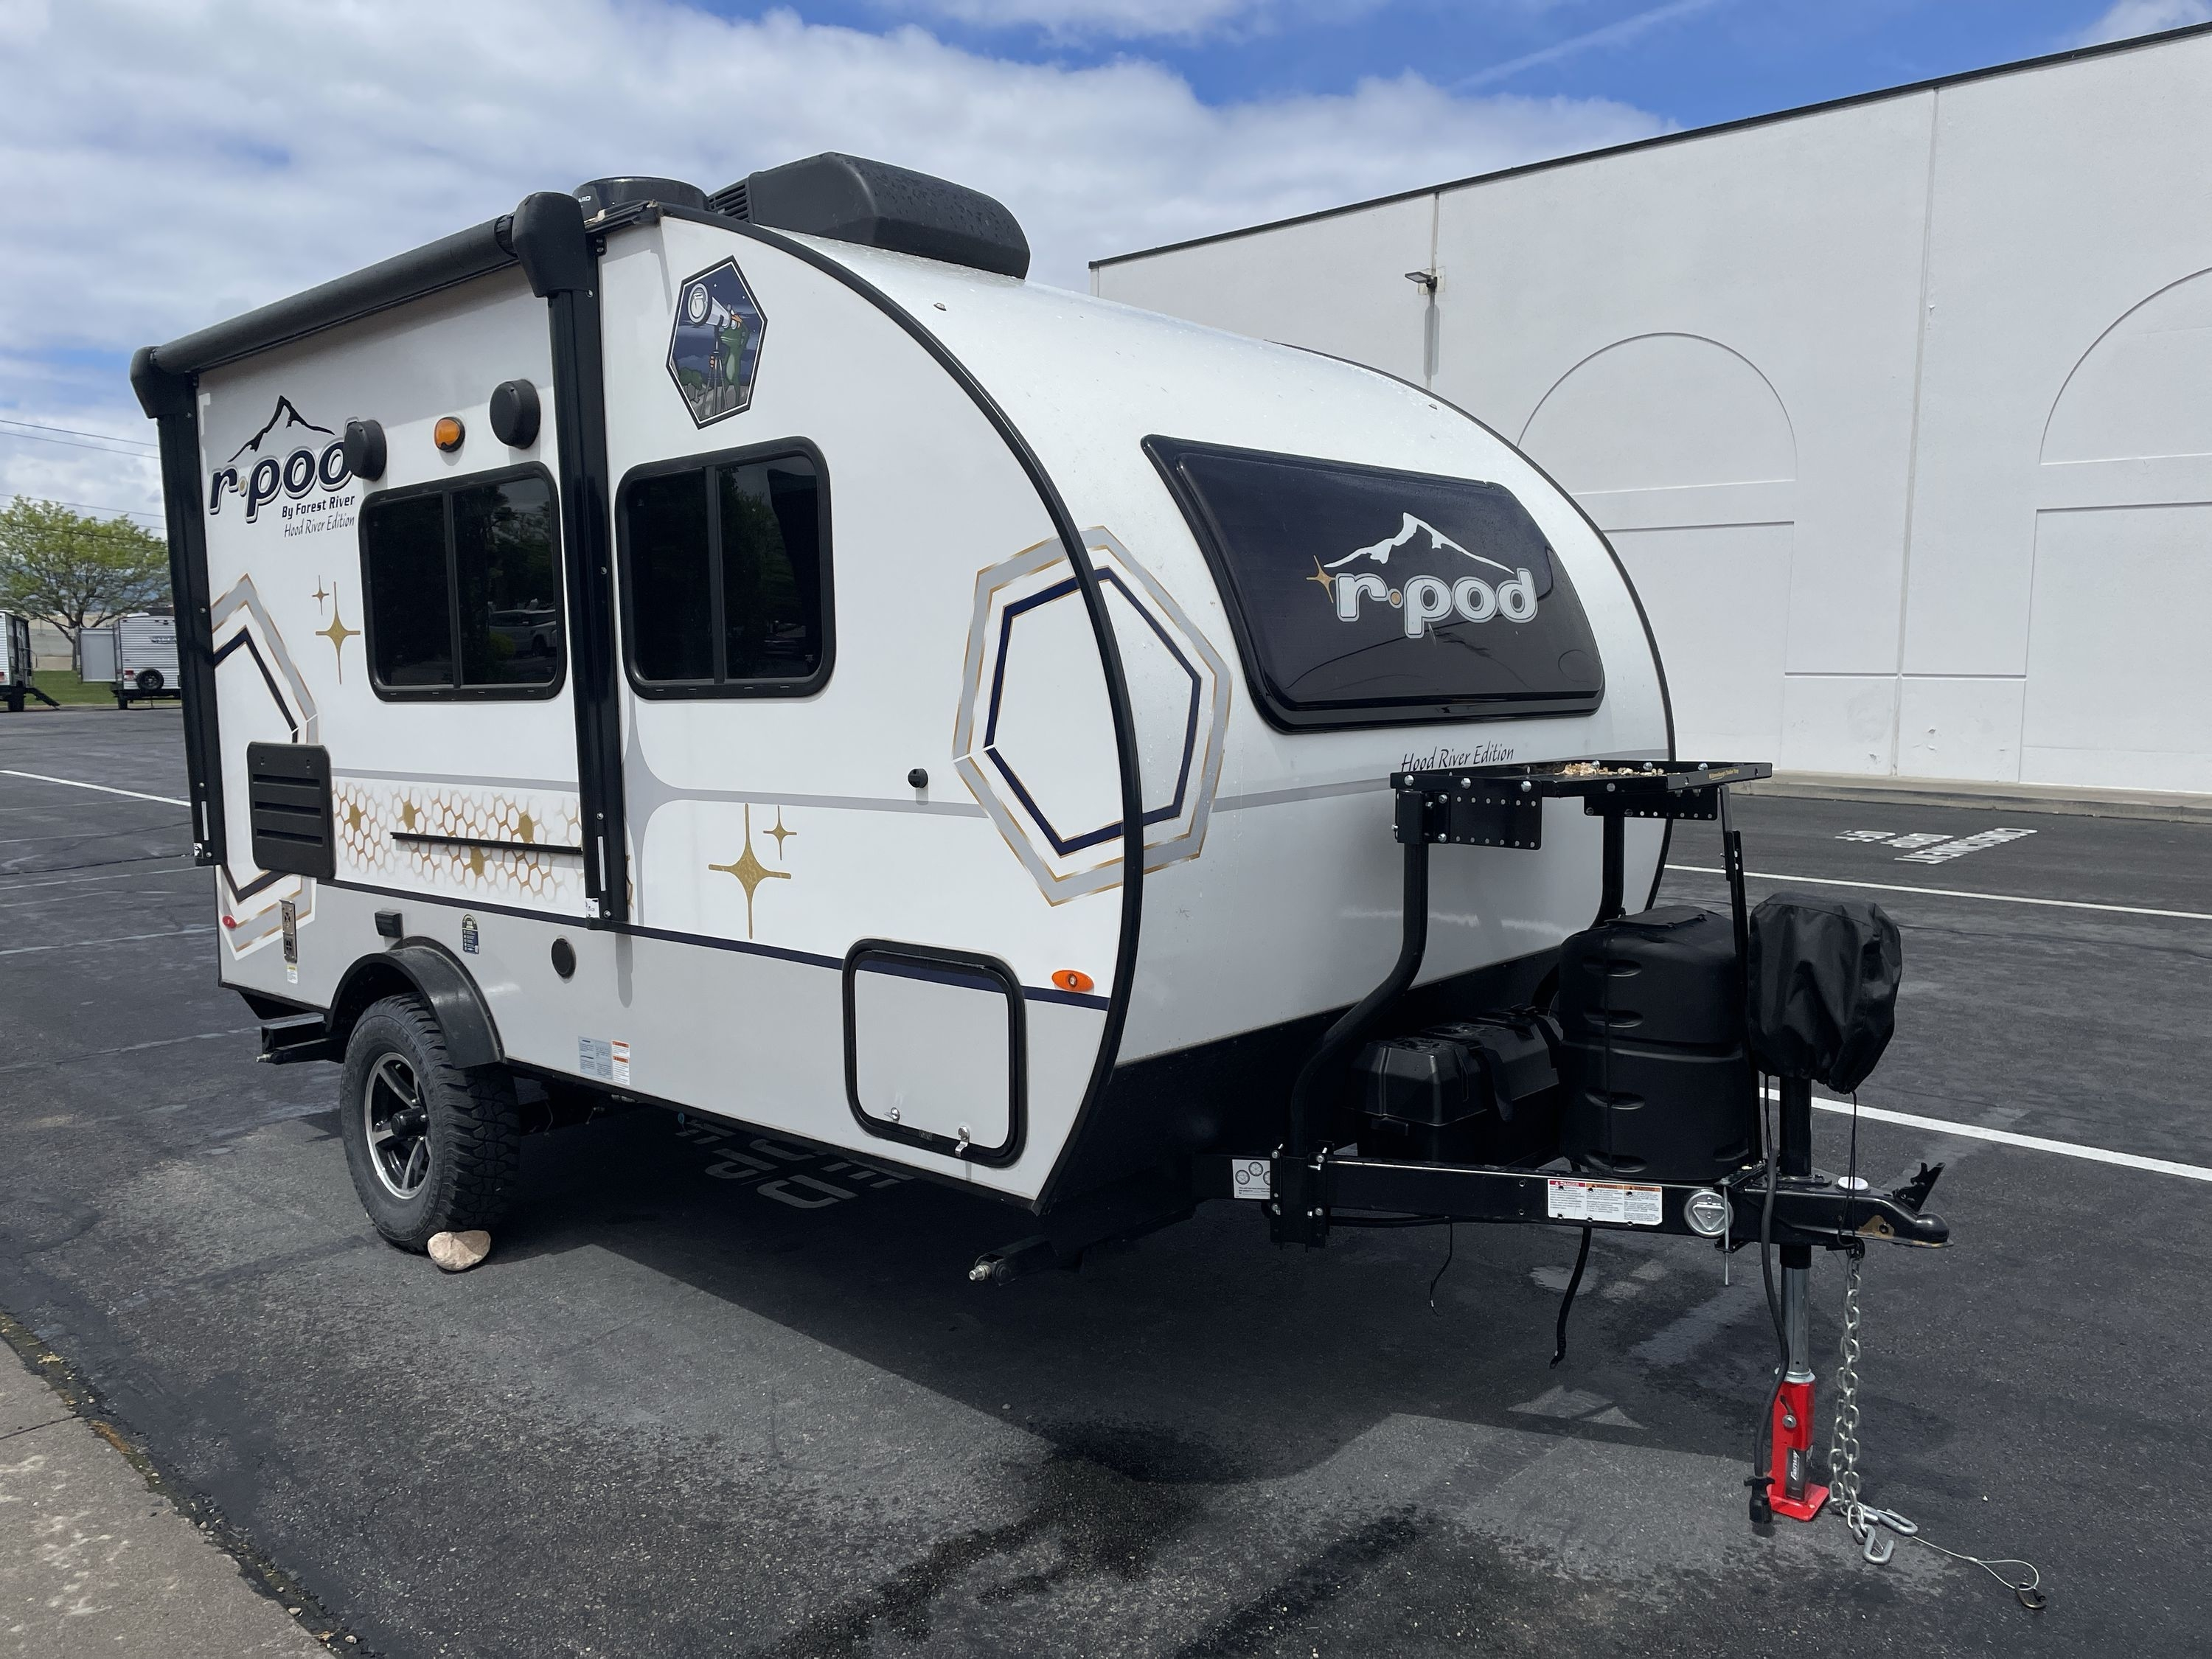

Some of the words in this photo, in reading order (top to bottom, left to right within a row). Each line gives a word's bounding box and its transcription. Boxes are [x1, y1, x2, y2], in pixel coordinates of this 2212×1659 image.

[282, 506, 294, 520] By
[296, 500, 327, 515] Forest
[329, 495, 355, 509] River
[285, 518, 305, 538] Hood
[305, 519, 325, 533] River
[327, 511, 354, 531] Edition
[1402, 745, 1437, 772] Hood
[1439, 748, 1471, 768] River
[1475, 740, 1514, 765] Edition
